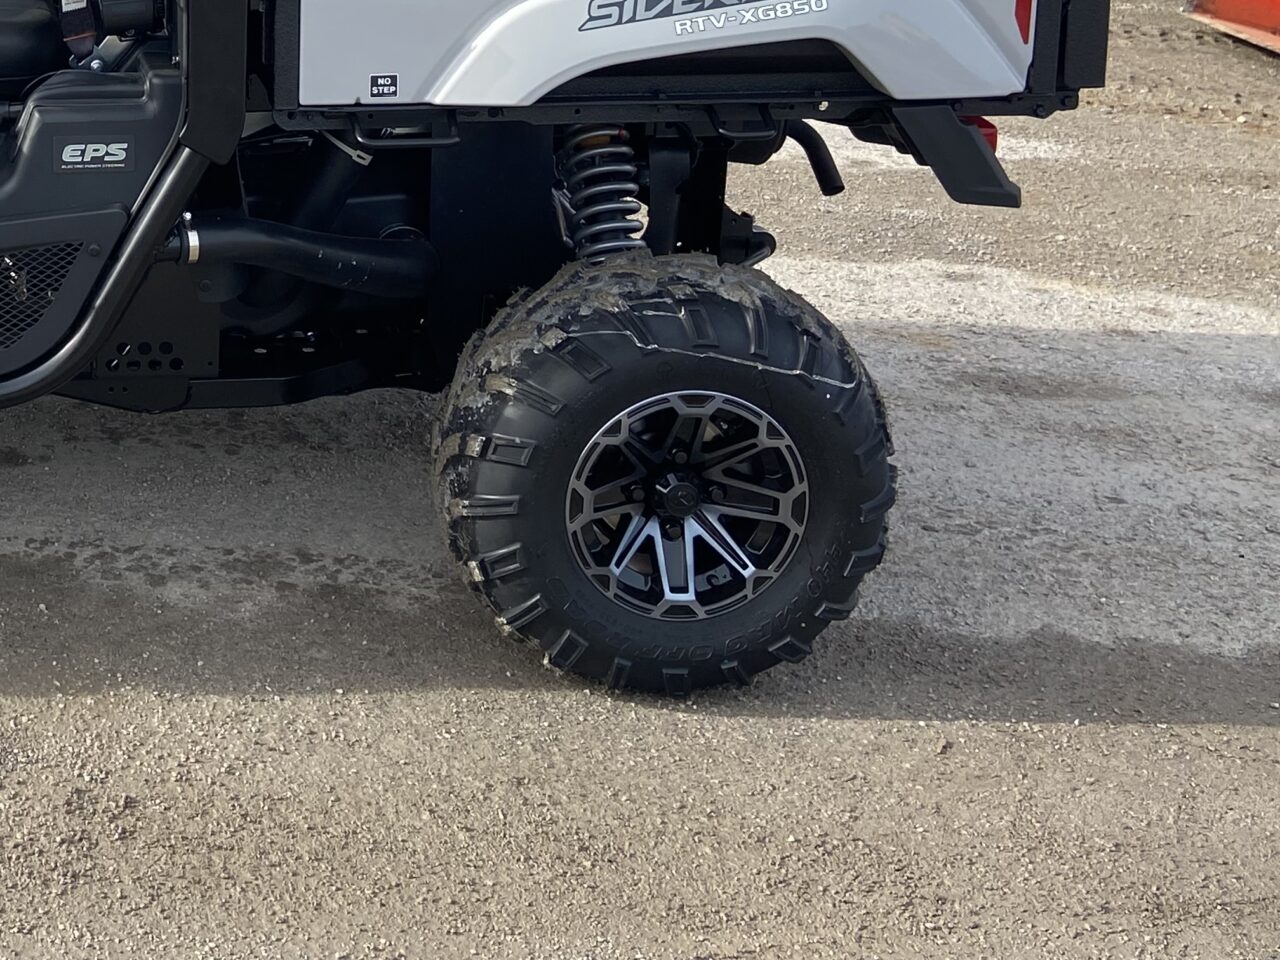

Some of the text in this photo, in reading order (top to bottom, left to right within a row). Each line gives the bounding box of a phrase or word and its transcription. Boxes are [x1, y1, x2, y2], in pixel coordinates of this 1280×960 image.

[377, 77, 391, 85] NO
[372, 86, 396, 94] STEP
[61, 143, 128, 162] EPS
